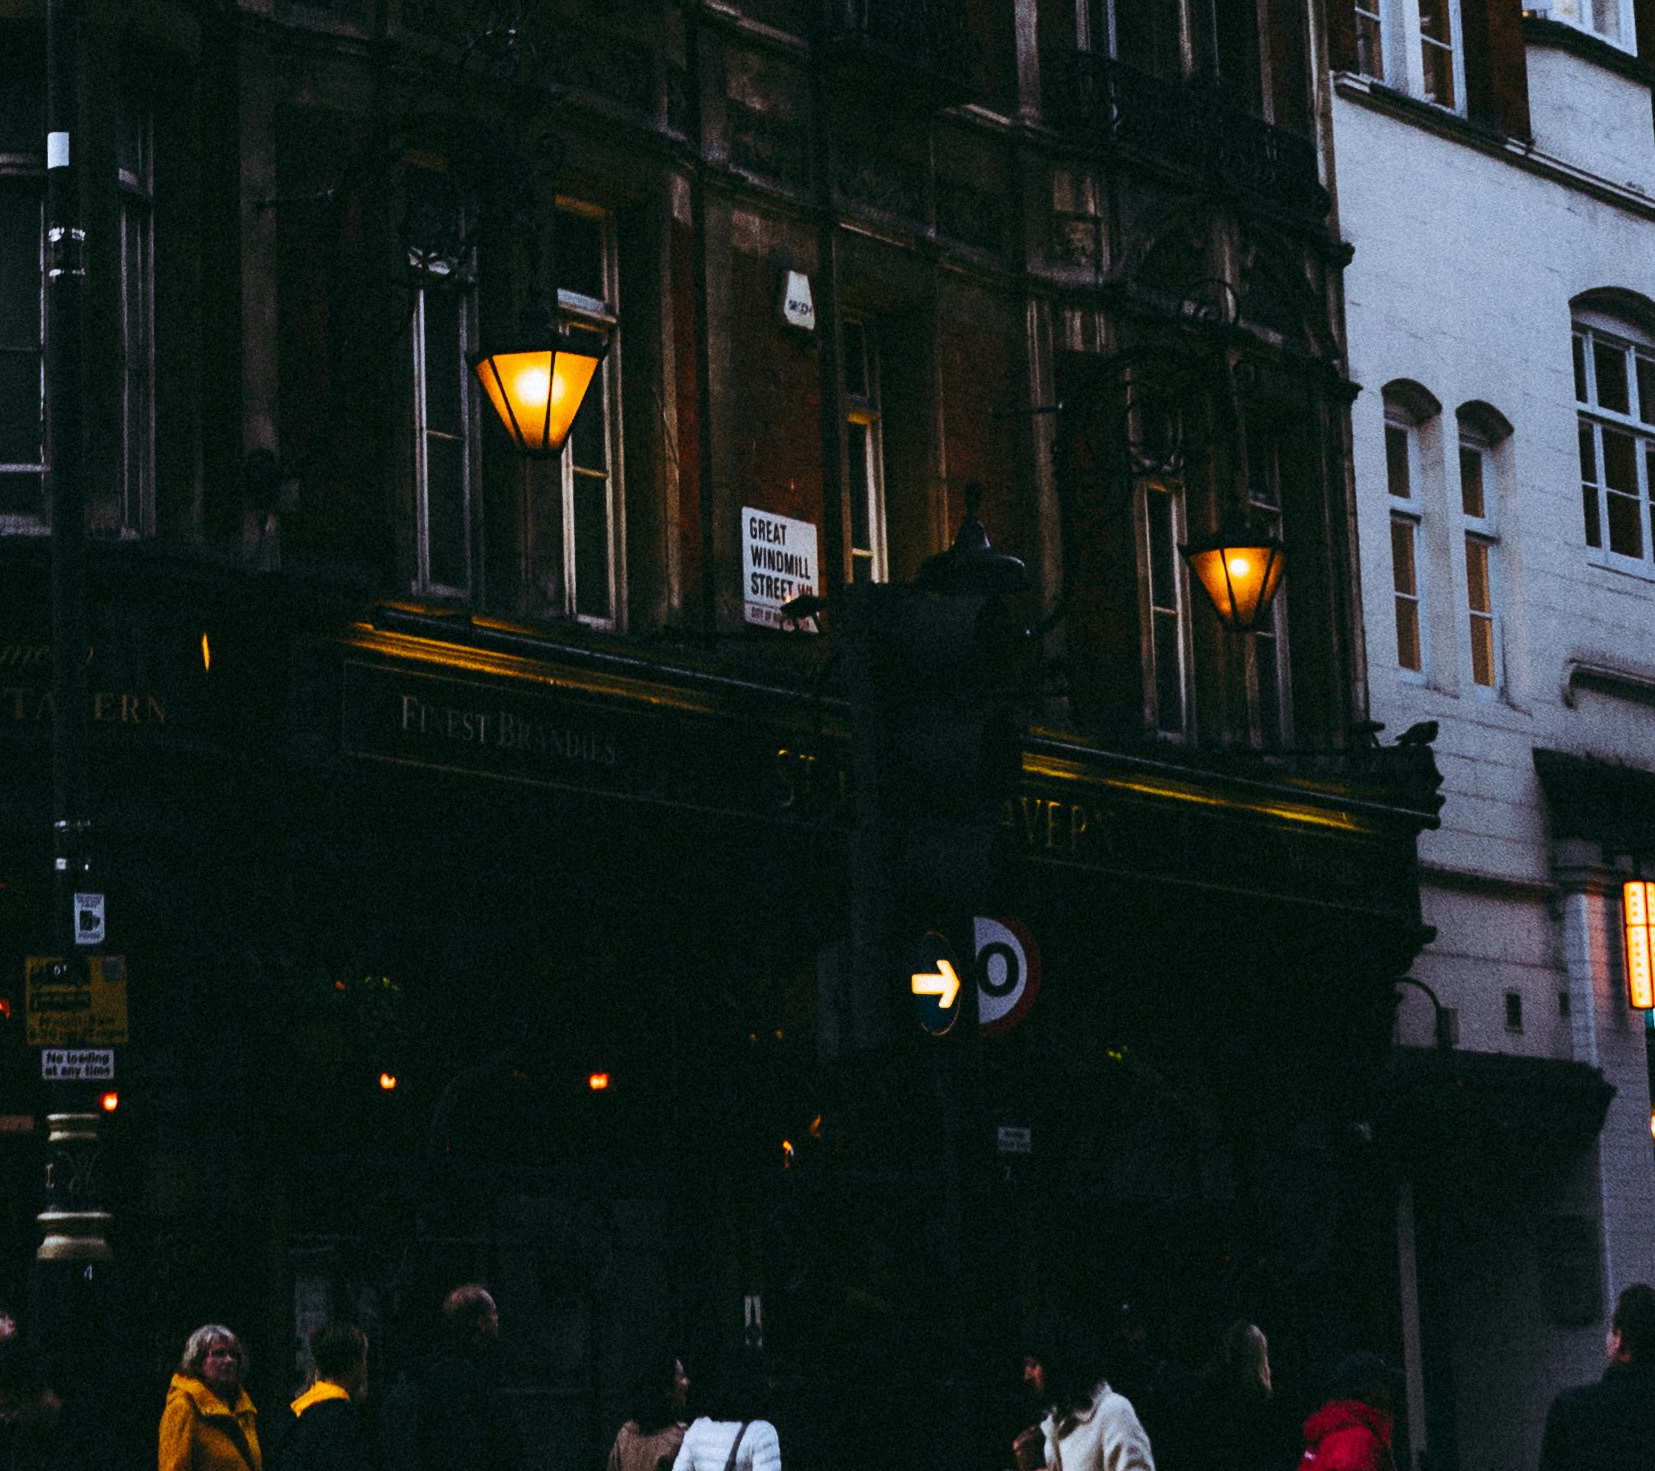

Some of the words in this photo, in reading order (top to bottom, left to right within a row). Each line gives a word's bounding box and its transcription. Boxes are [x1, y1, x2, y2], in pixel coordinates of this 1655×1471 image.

[750, 516, 787, 546] GREAT
[750, 545, 811, 580] WINDMILL
[751, 572, 794, 601] STREET
[4, 687, 167, 725] TAERN
[45, 1065, 57, 1076] at
[61, 1066, 81, 1078] any
[85, 1064, 111, 1076] time
[46, 1051, 63, 1064] No
[67, 1050, 110, 1066] loading
